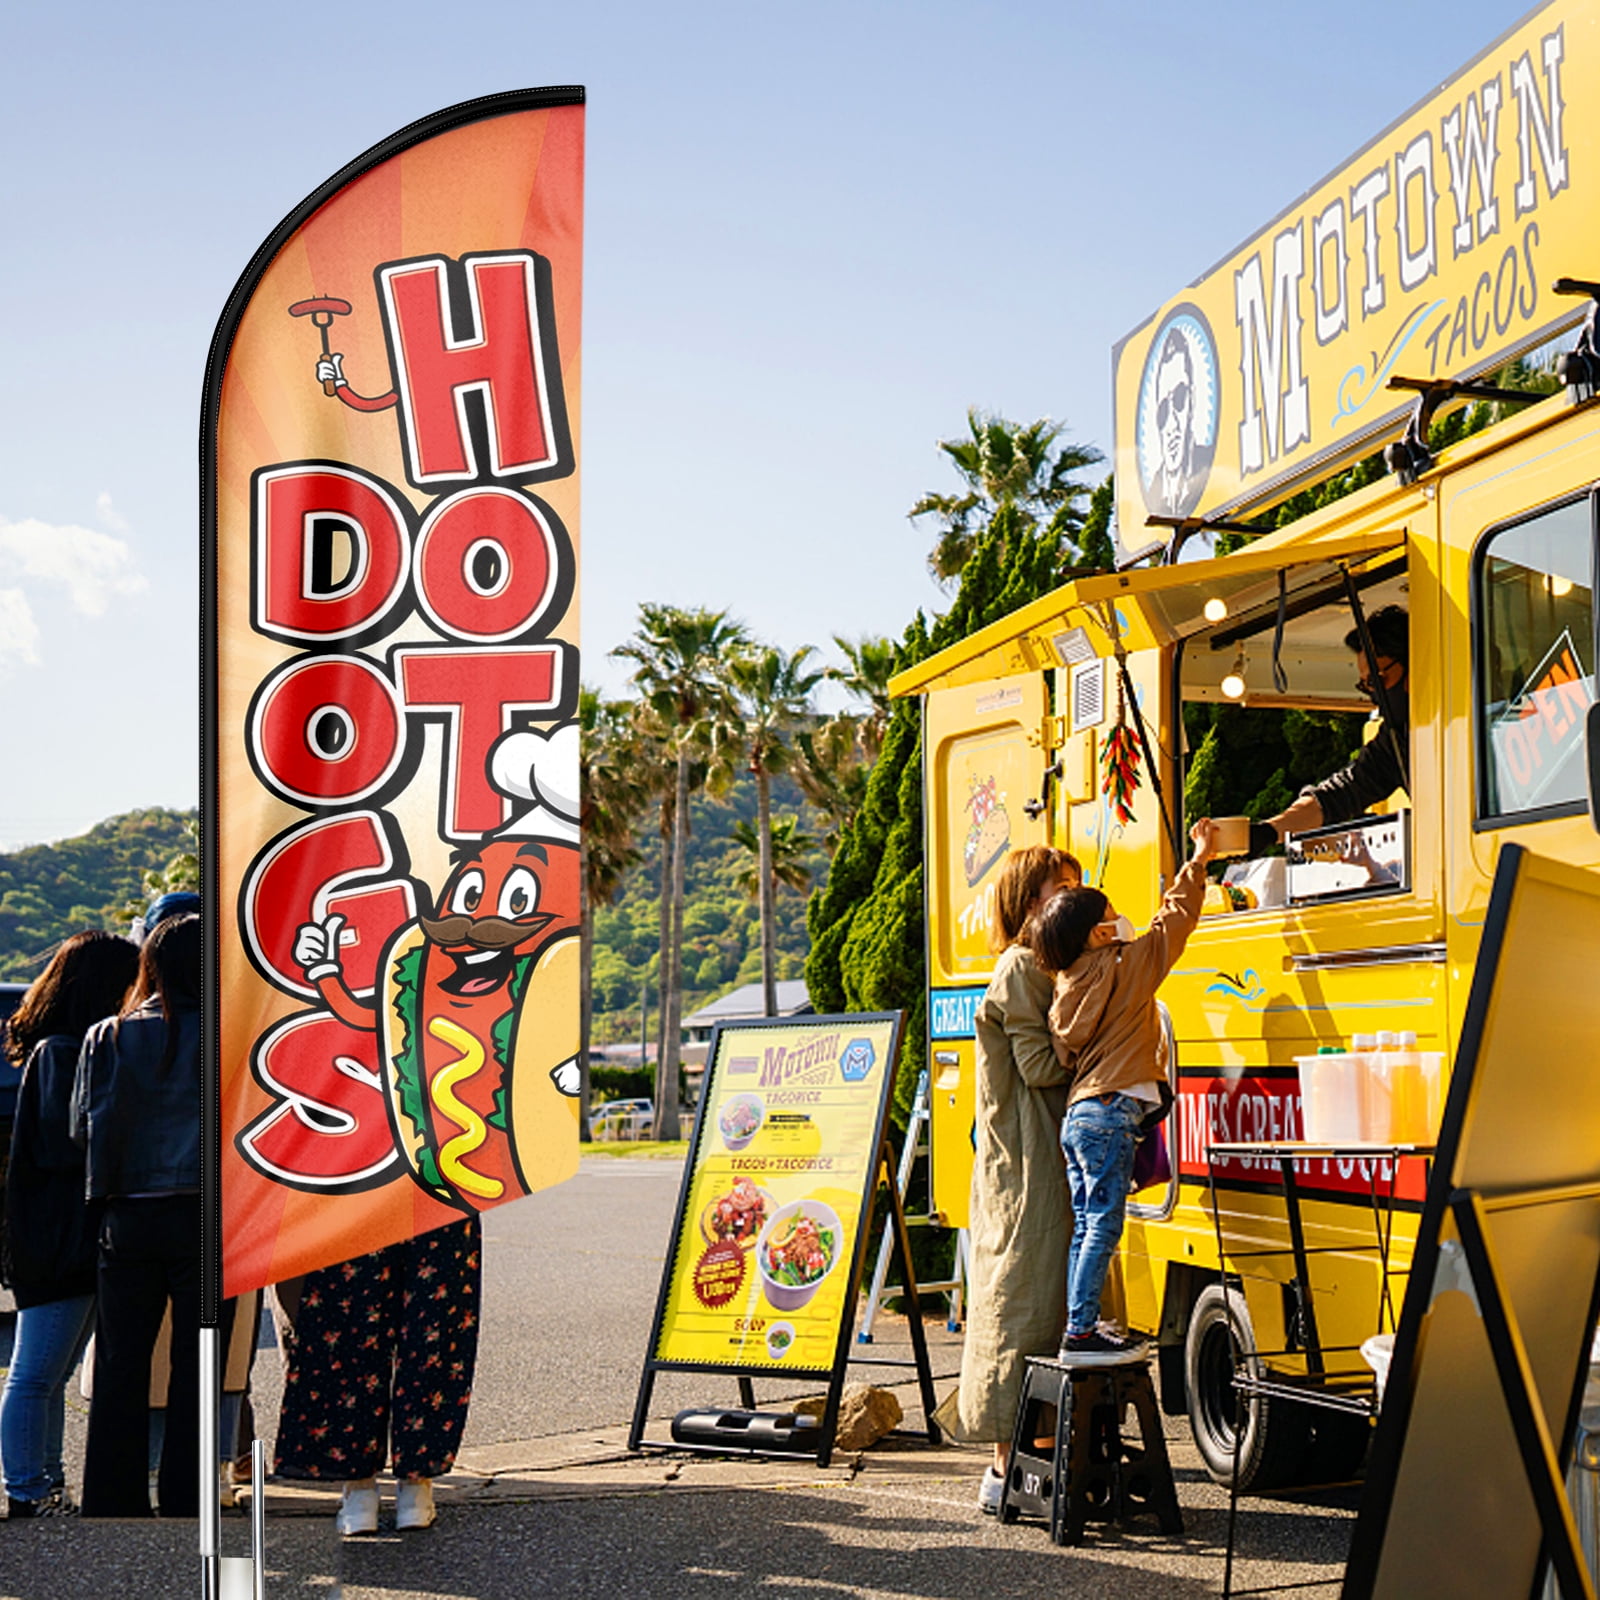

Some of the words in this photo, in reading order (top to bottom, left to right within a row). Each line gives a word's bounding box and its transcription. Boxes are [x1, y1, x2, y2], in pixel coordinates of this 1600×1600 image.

[1234, 22, 1570, 480] MOTOWN
[1424, 222, 1539, 376] TACOS
[378, 250, 574, 842] HOT
[1504, 648, 1588, 786] OPEN
[238, 464, 420, 1192] DOGS
[957, 883, 996, 940] TAC
[932, 995, 972, 1034] GREAT
[731, 1158, 768, 1171] TACOS
